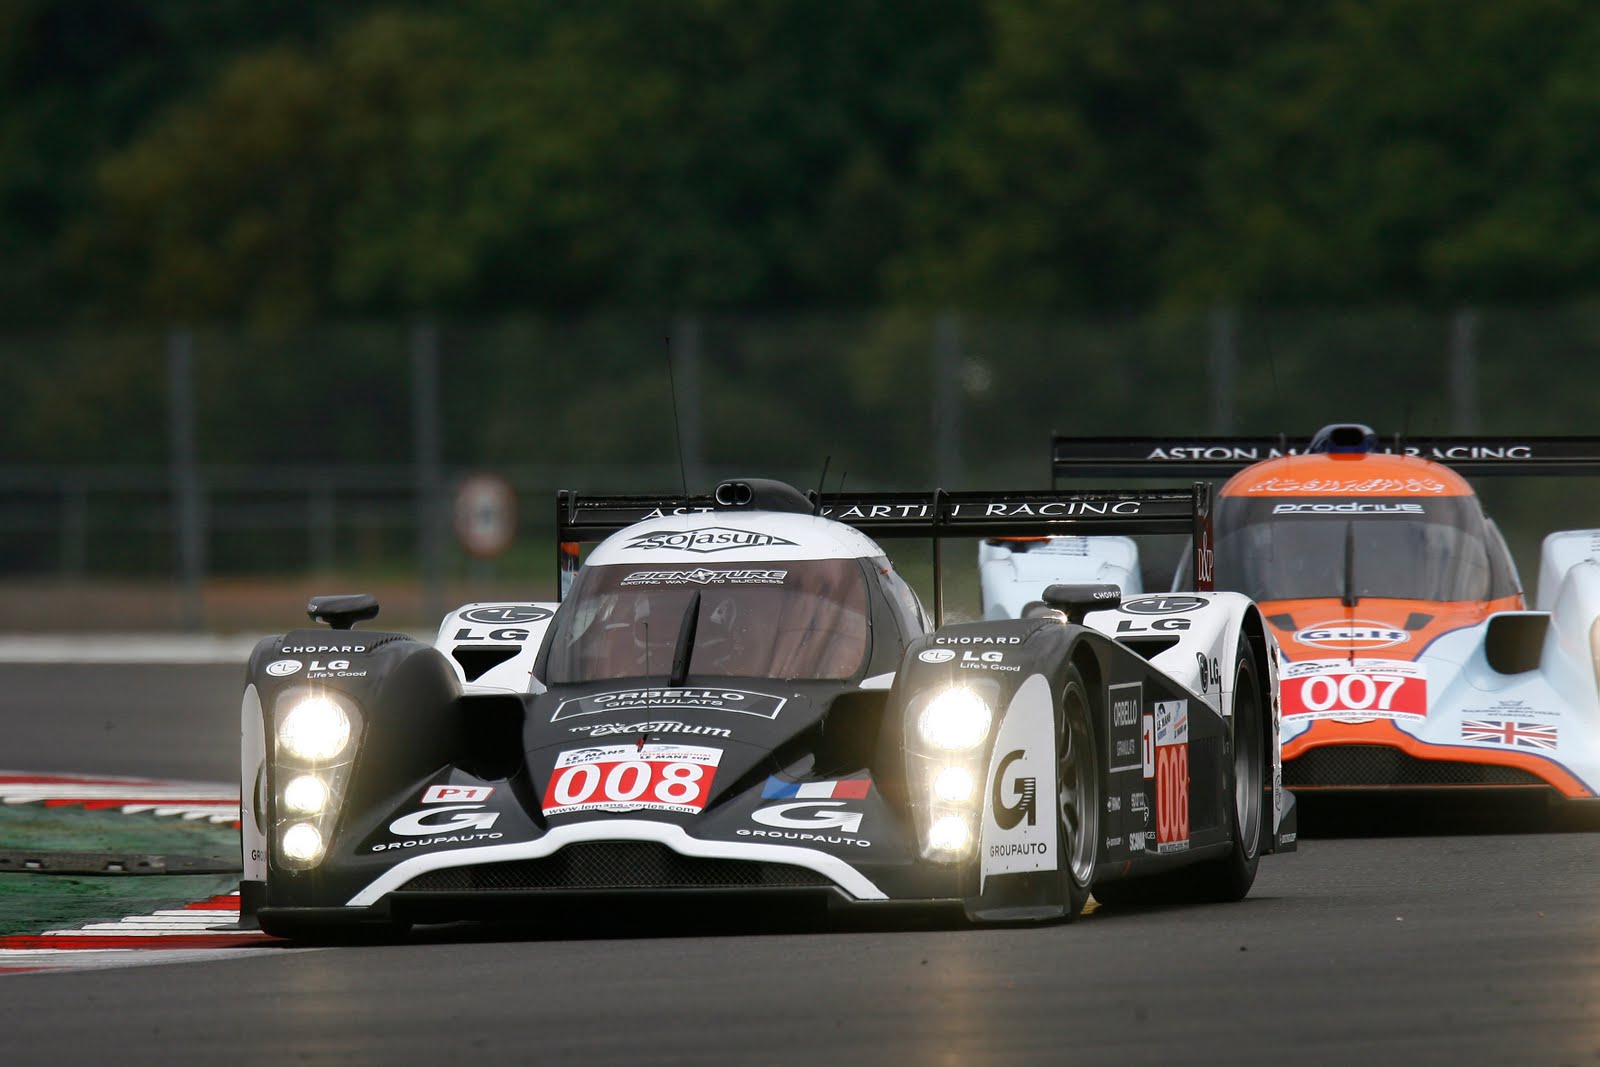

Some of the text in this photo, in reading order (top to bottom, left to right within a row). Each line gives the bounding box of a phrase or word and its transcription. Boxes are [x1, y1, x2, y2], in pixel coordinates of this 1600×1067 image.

[1147, 447, 1258, 460] ASTON
[985, 501, 1142, 516] RACING
[1272, 502, 1425, 514] prodrive
[643, 531, 774, 551] sojasun
[1116, 618, 1192, 633] LG
[453, 628, 531, 641] LG
[1300, 630, 1402, 640] Gulf
[936, 637, 1020, 645] CHOPARD
[282, 645, 366, 653] CHOPARD
[962, 651, 1004, 662] LG
[309, 660, 350, 671] LG
[990, 664, 1021, 672] Good
[1209, 657, 1219, 685] LG
[307, 671, 334, 679] Life's
[594, 691, 745, 703] ORBELLO
[1301, 675, 1406, 711] 007
[606, 699, 724, 707] GRANULATS
[568, 723, 626, 733] TOTAL
[585, 749, 626, 758] MANS
[554, 761, 704, 805] 008
[436, 788, 478, 799] P1
[1157, 744, 1189, 843] 008
[372, 832, 504, 852] GROUPAUTO
[736, 829, 872, 847] GROUPAUTO
[989, 842, 1048, 858] GROUPAUTO
